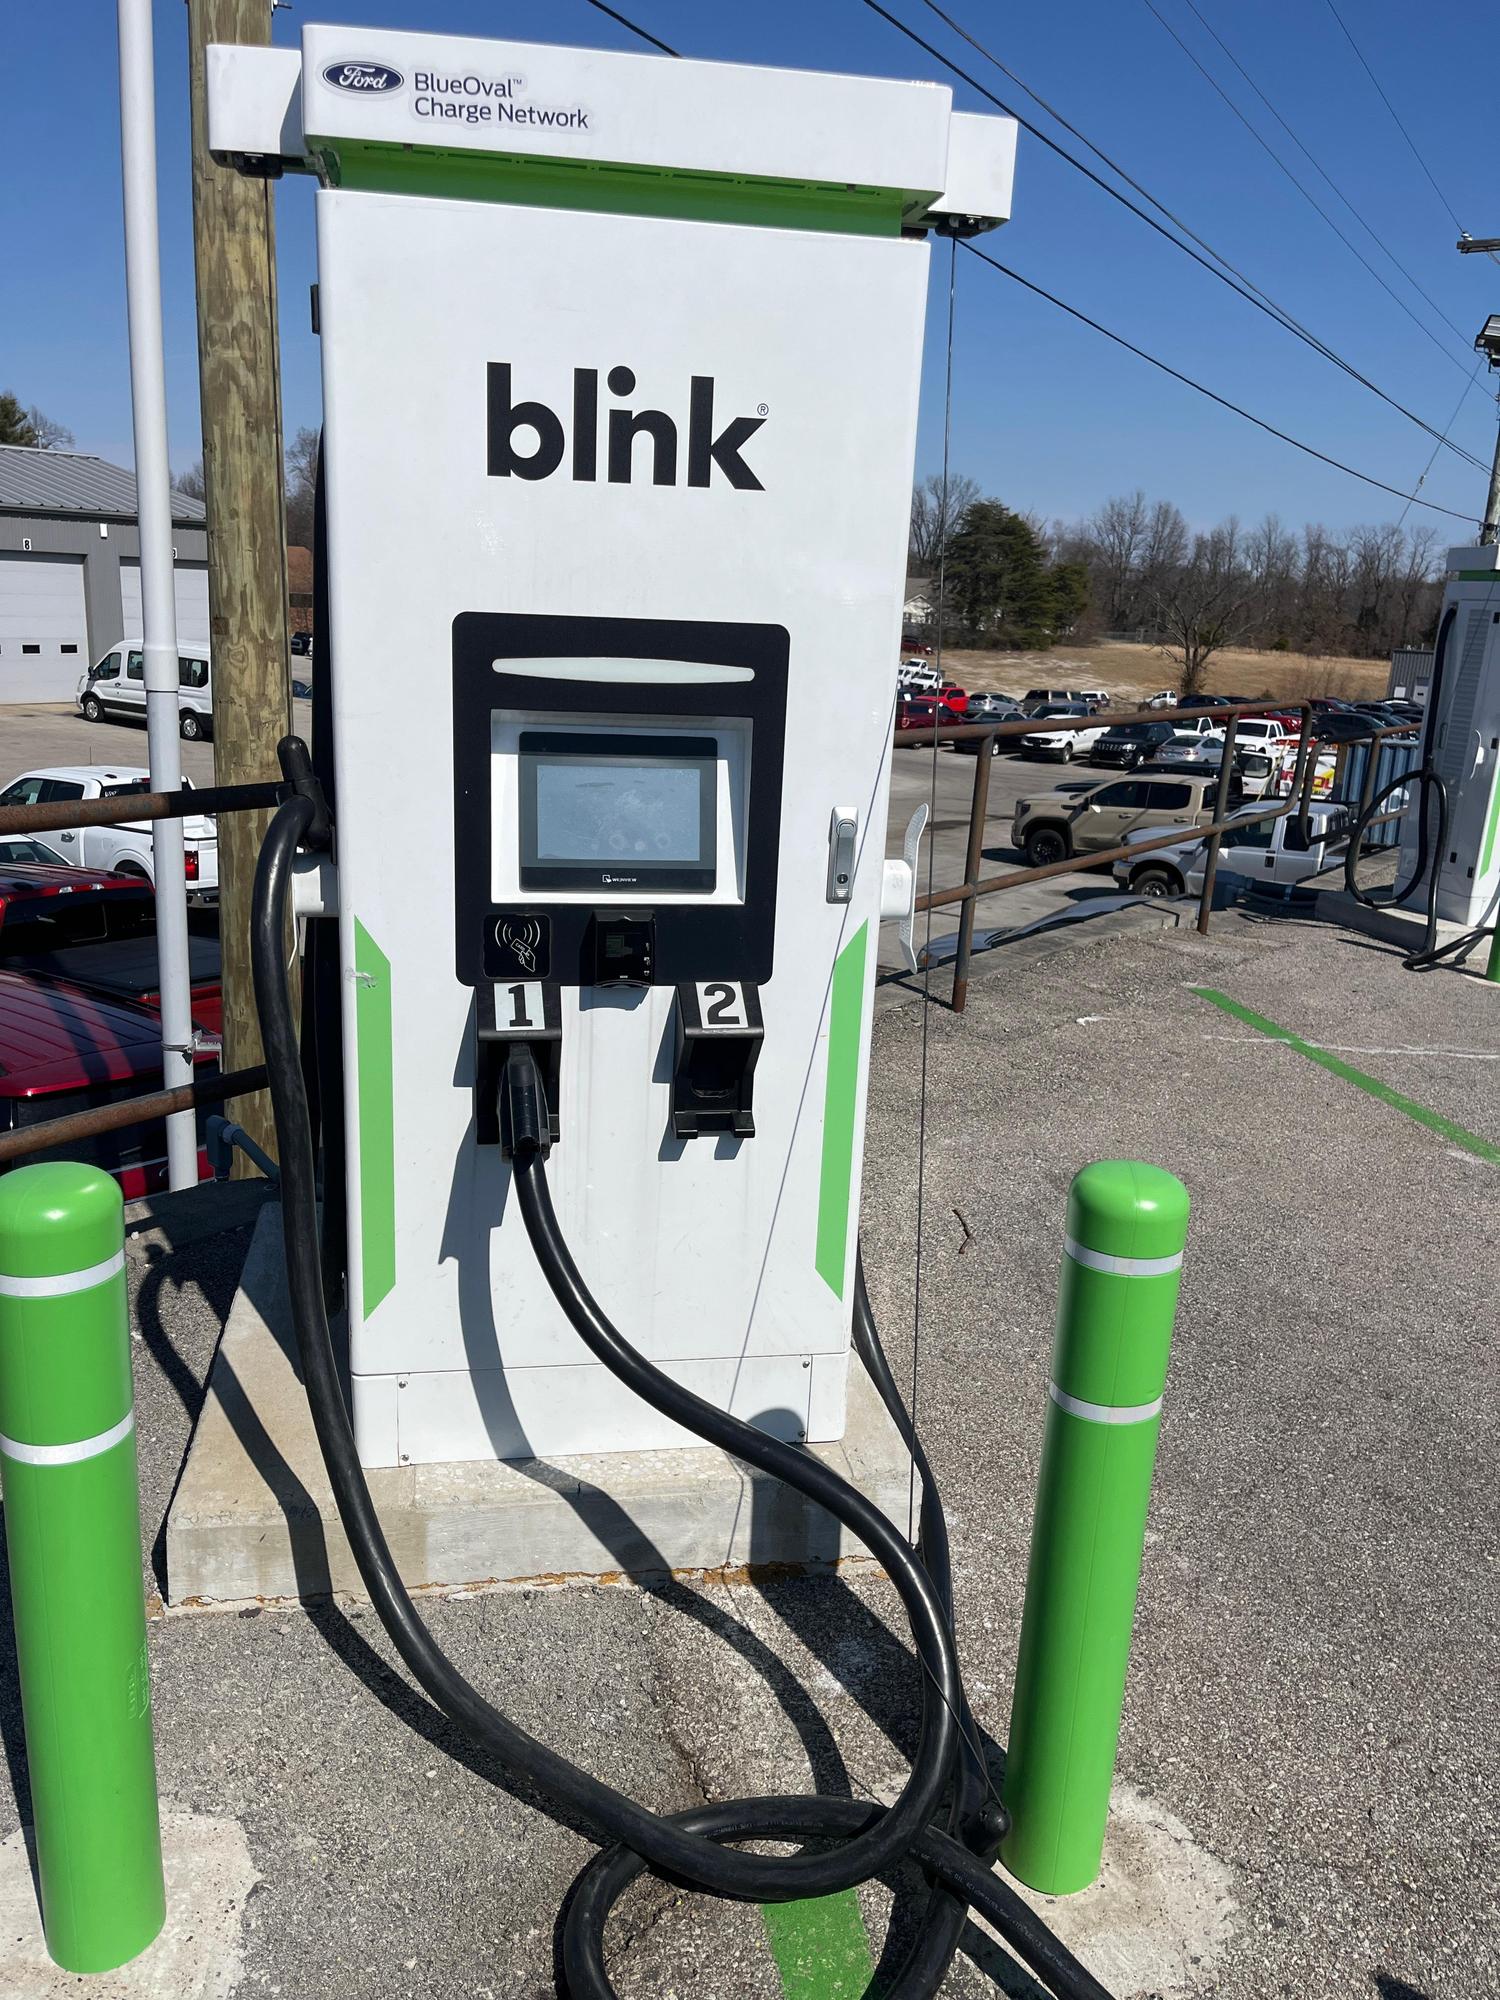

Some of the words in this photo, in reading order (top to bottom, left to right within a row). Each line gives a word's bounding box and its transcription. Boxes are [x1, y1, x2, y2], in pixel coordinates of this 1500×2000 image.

[339, 65, 388, 90] Ford
[414, 97, 492, 123] Charge
[498, 103, 589, 129] Network
[24, 539, 30, 550] 8
[508, 983, 533, 1028] 1
[703, 983, 741, 1025] 2
